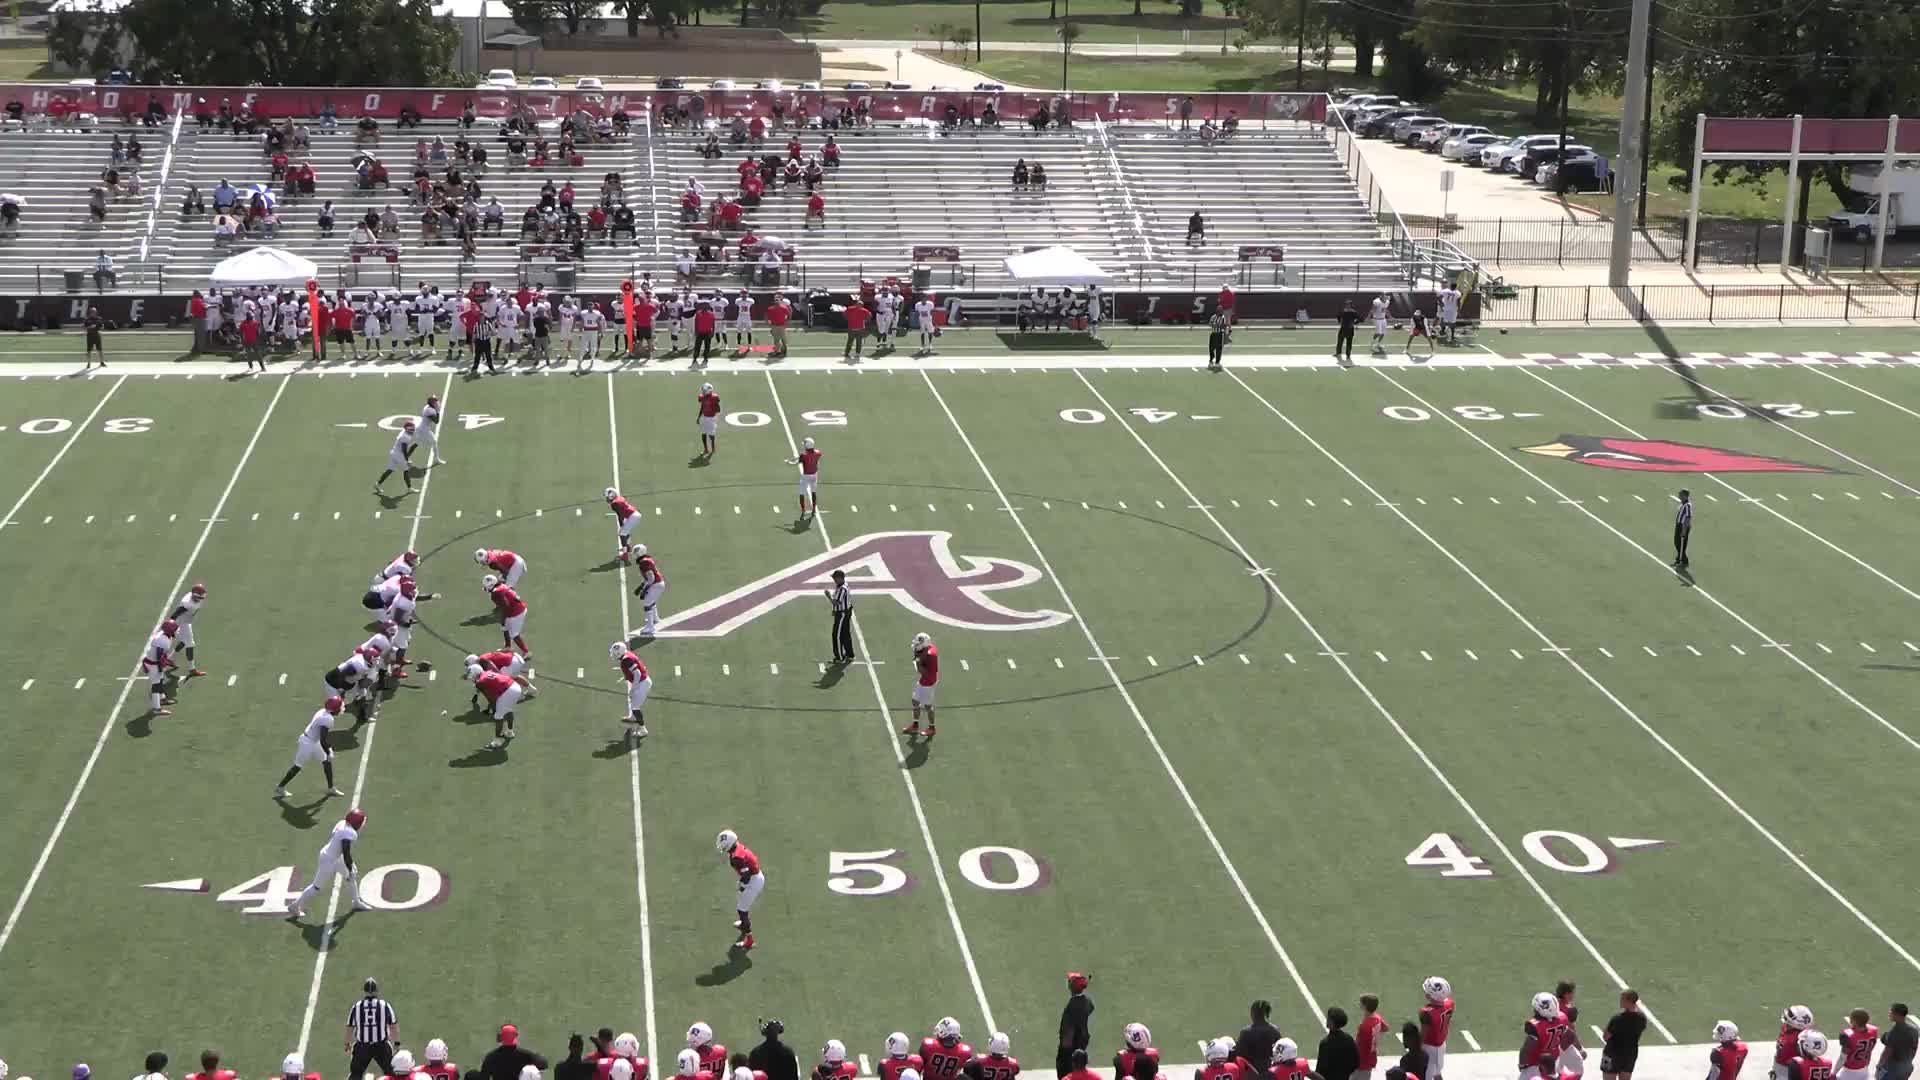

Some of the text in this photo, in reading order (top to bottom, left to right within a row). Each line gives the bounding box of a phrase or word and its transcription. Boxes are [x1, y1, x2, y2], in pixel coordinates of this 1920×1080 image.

[364, 94, 446, 112] OF
[724, 410, 848, 427] 50
[1059, 408, 1178, 424] 40
[1383, 405, 1505, 421] 30
[19, 417, 154, 434] 30
[1404, 830, 1609, 877] 40
[827, 846, 1041, 895] 50
[216, 863, 444, 914] 40
[364, 1008, 377, 1026] H
[931, 1053, 959, 1077] 98
